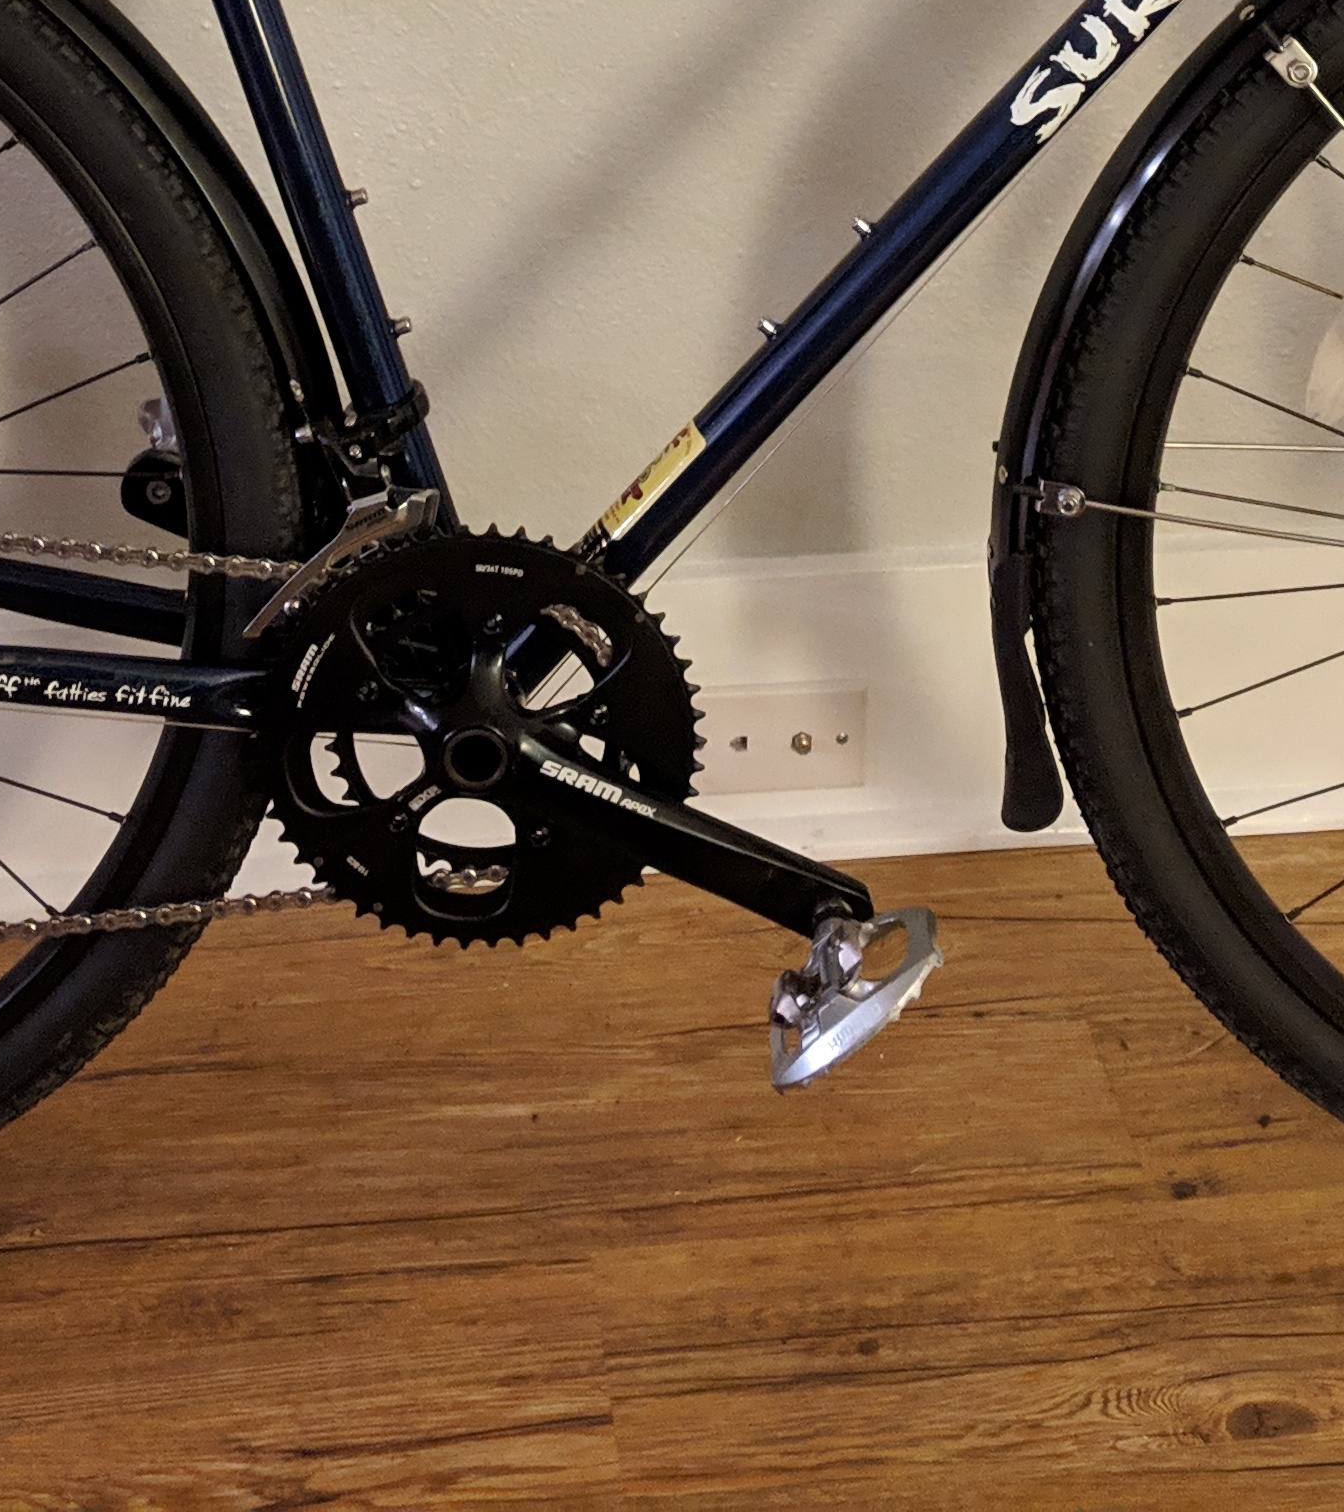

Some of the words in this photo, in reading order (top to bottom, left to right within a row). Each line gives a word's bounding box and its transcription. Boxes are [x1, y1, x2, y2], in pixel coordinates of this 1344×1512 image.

[291, 643, 319, 693] SRAM
[43, 680, 108, 703] fatties
[114, 684, 148, 705] fit
[148, 684, 192, 708] fine
[540, 759, 623, 805] SRAM
